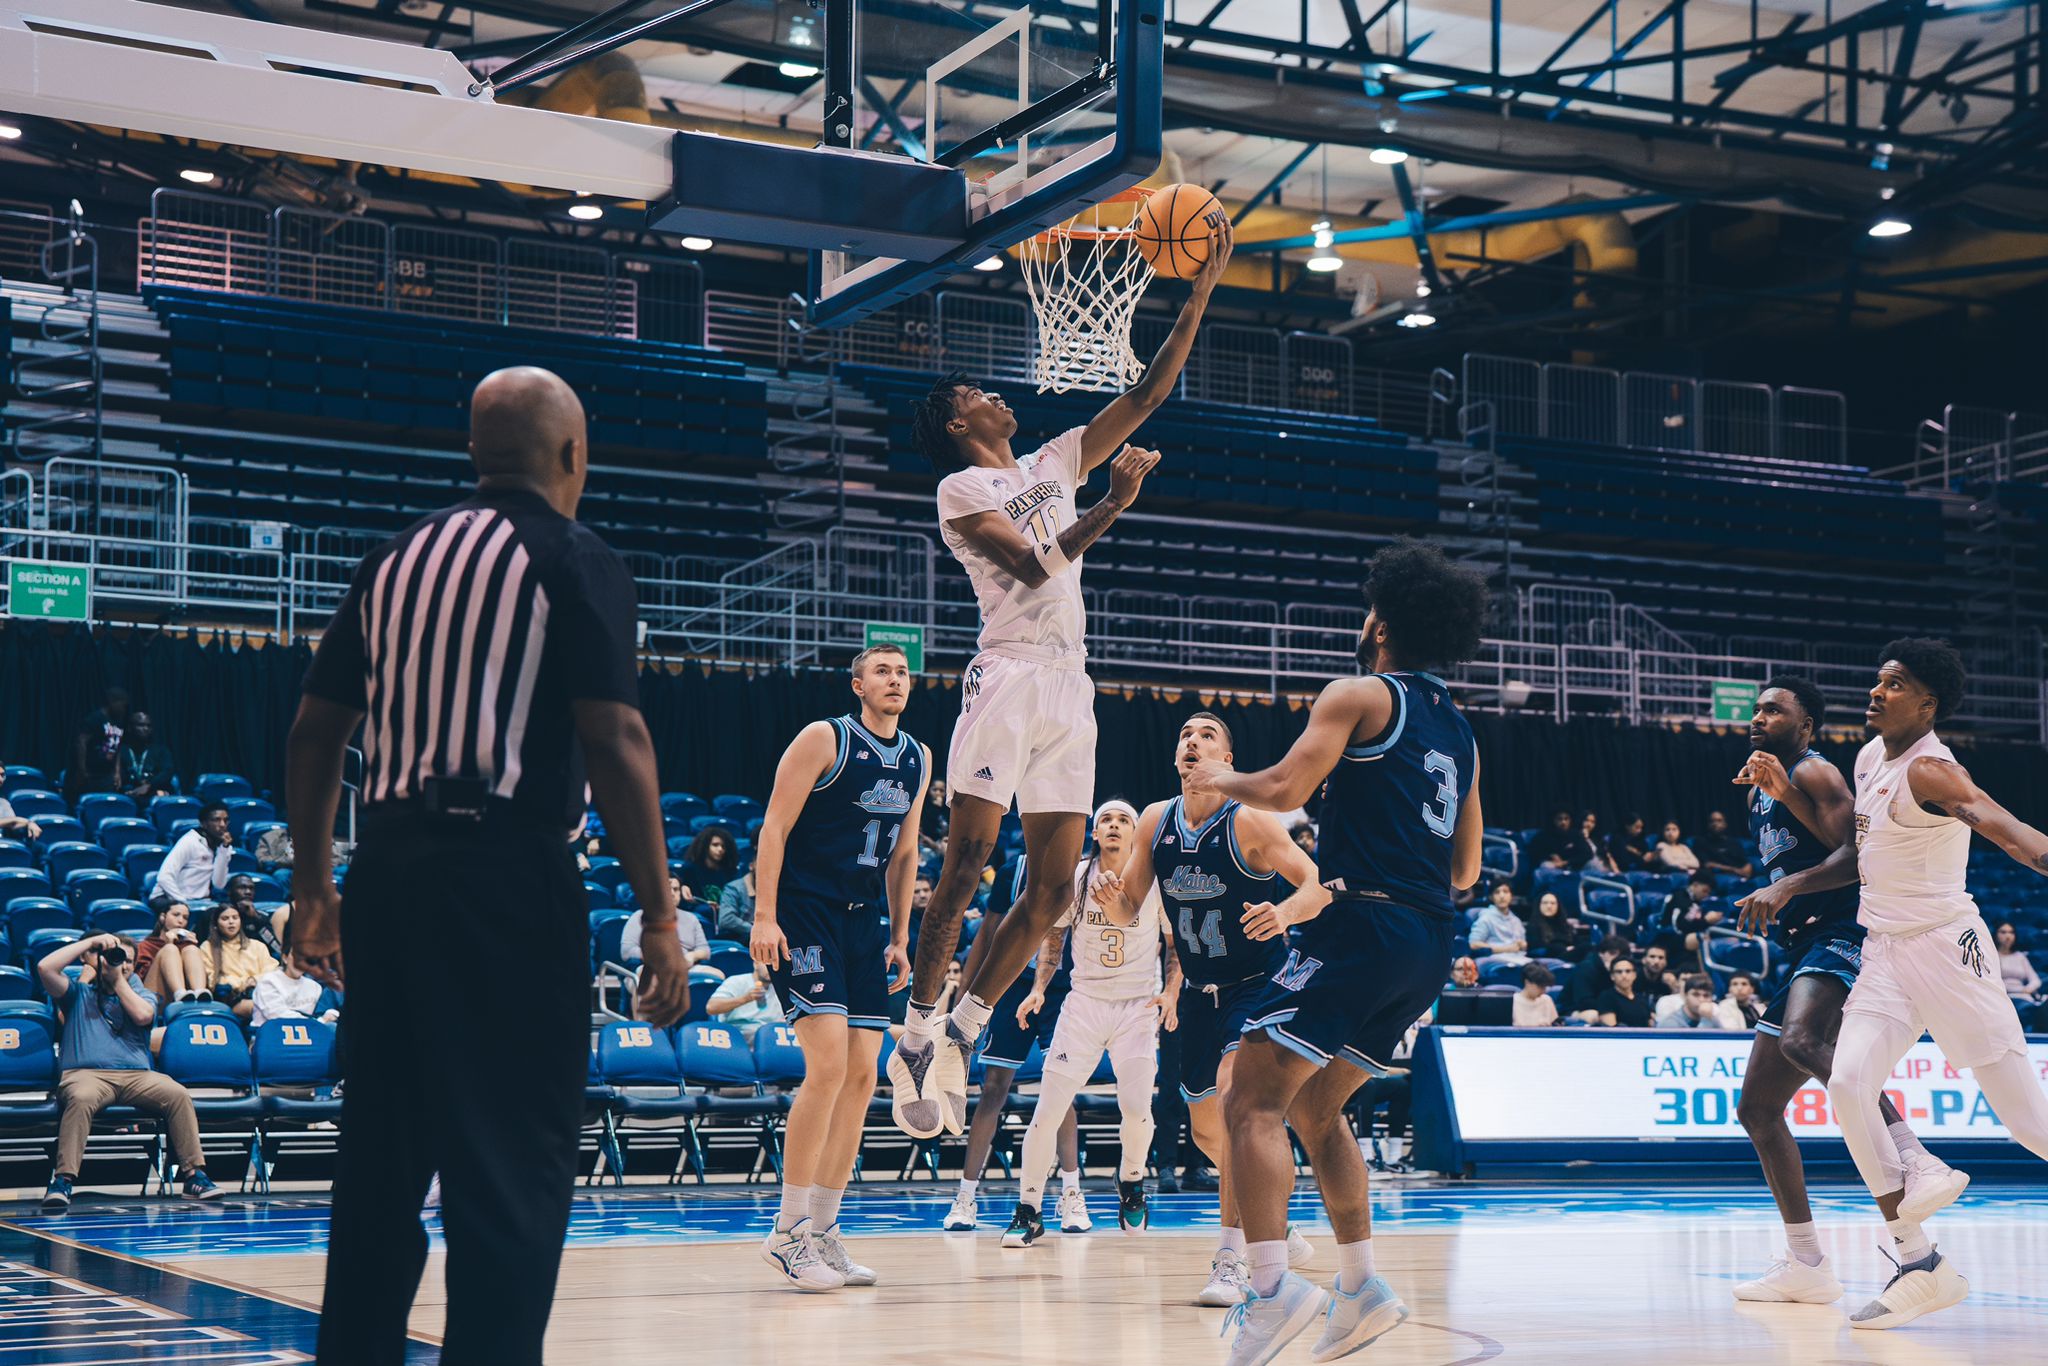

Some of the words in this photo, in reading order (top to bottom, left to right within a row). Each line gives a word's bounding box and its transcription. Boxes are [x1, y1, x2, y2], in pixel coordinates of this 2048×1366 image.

[17, 571, 70, 586] SECTION
[71, 575, 81, 586] A
[1422, 749, 1458, 839] 3
[857, 820, 900, 868] 11
[1163, 865, 1228, 895] Maine
[1178, 907, 1228, 958] 44
[789, 945, 825, 976] M
[1100, 928, 1125, 968] 3
[1272, 948, 1323, 991] M
[189, 1023, 228, 1046] 10
[281, 1025, 312, 1045] 11
[616, 1027, 653, 1048] 15
[1643, 1056, 1698, 1077] CAR
[1710, 1056, 1746, 1077] AC
